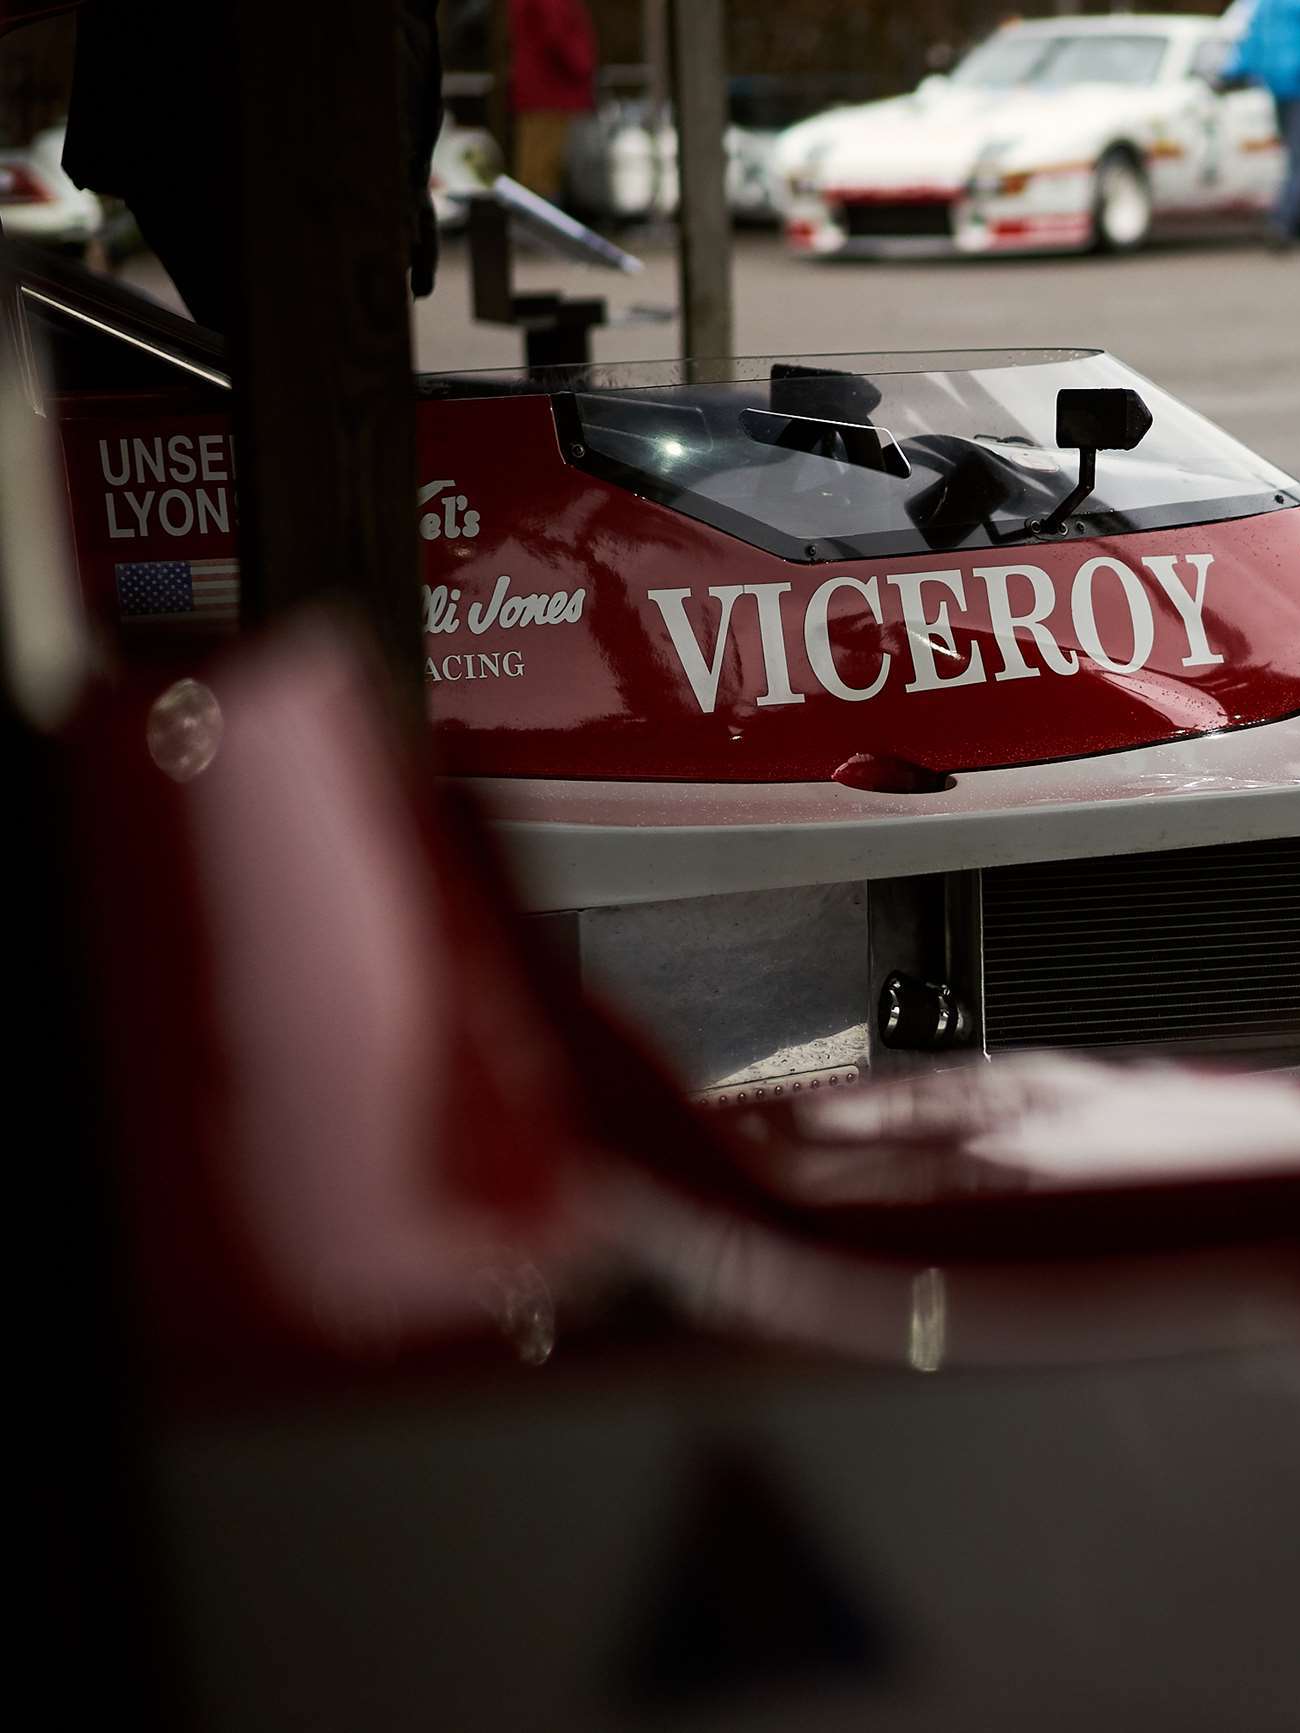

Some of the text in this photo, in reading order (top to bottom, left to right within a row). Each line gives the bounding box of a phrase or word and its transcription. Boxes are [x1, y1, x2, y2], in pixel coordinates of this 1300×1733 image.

[104, 487, 240, 539] LYON
[416, 479, 481, 541] el's
[467, 574, 587, 635] Jones
[647, 553, 1225, 714] VICEROY
[424, 650, 526, 682] ACING
